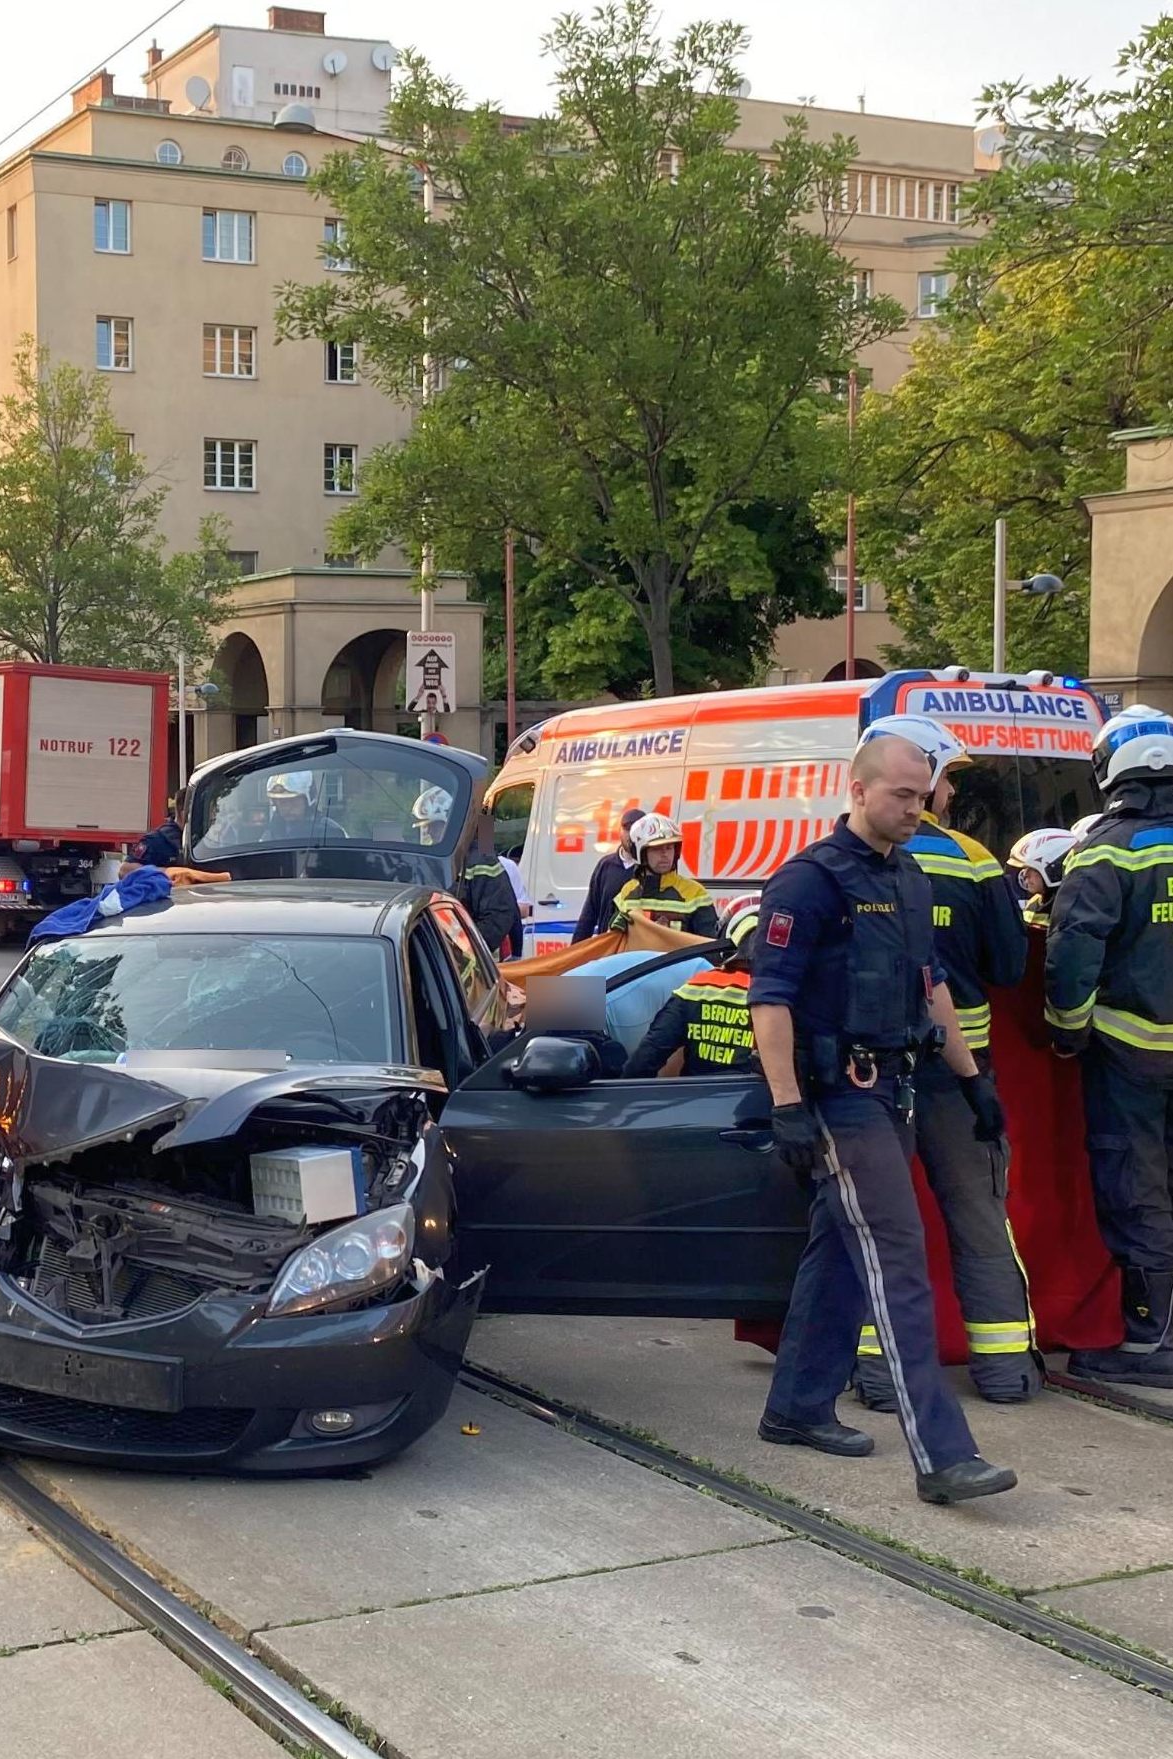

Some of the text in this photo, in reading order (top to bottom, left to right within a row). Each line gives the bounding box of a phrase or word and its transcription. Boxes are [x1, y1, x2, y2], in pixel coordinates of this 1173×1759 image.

[922, 690, 1088, 720] AMBULANCE
[39, 737, 141, 757] NOTRUF 122
[555, 729, 685, 764] AMBULANCE
[944, 723, 1093, 753] RUFSRETTUNG
[701, 1003, 749, 1026] BERUFS
[698, 1042, 735, 1065] WIEN
